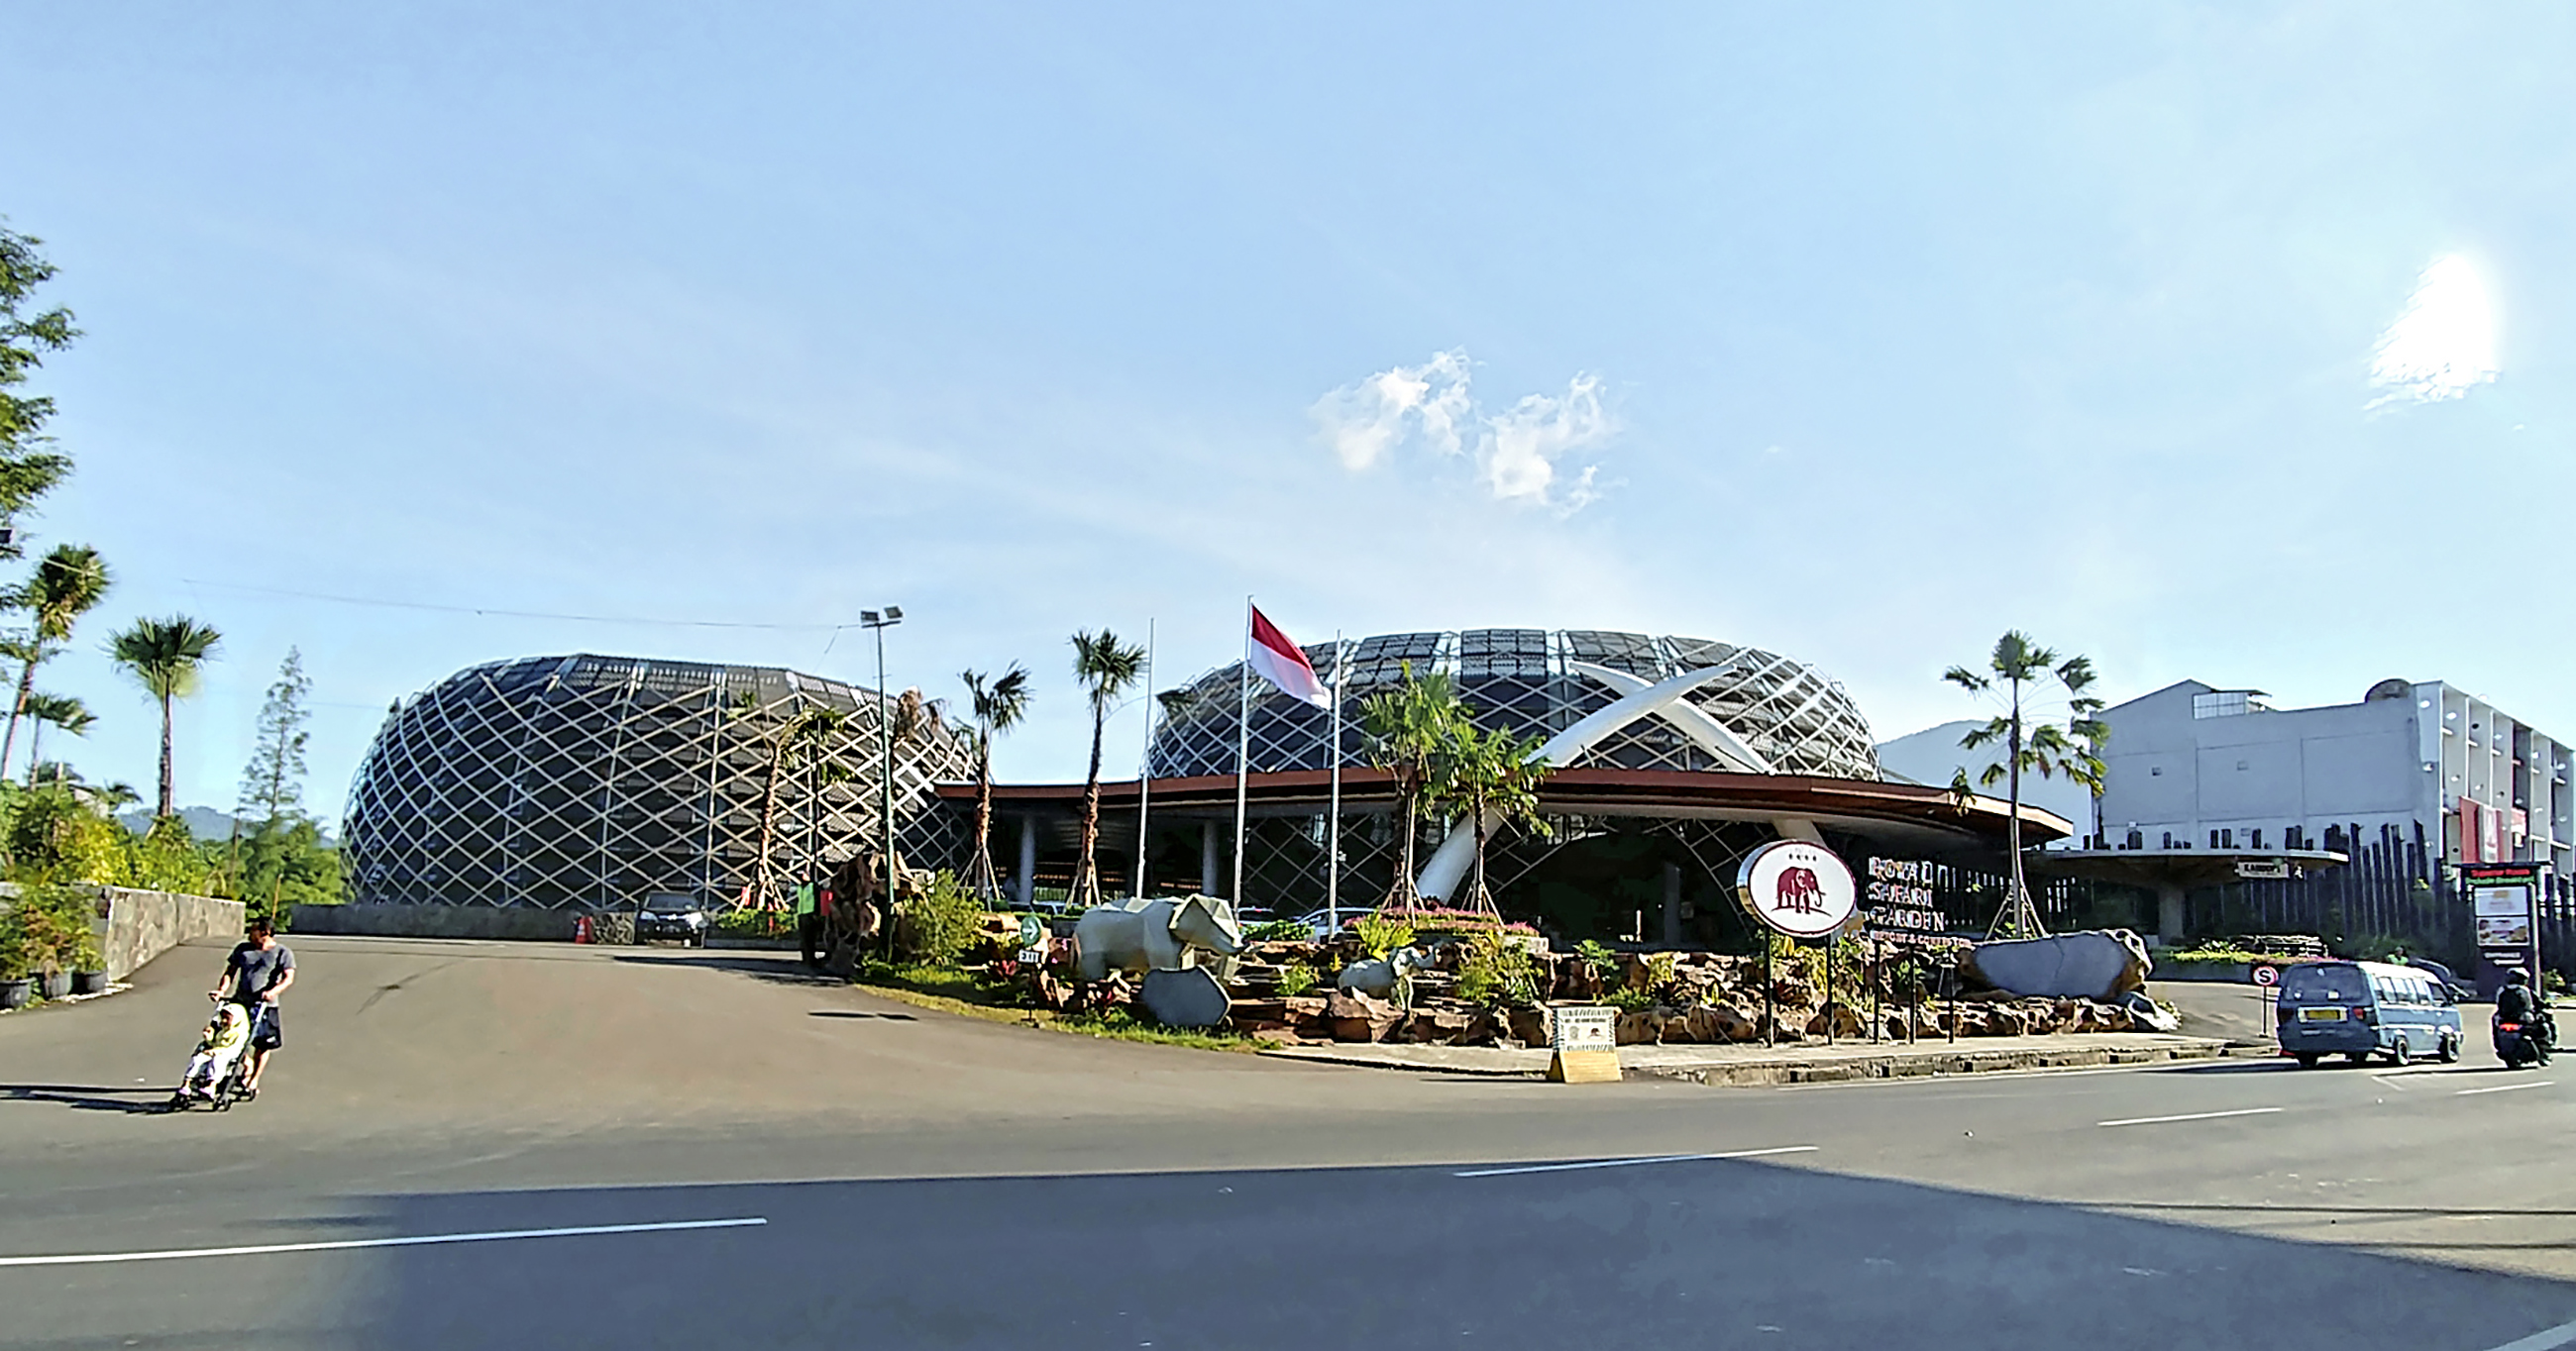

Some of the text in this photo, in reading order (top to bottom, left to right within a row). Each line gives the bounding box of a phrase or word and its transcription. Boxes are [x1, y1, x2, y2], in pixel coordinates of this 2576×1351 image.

[1868, 882, 1933, 908] SAFARI
[1870, 905, 1945, 931] GARDEN
[1019, 950, 1039, 963] EXIT
[2259, 969, 2272, 983] S
